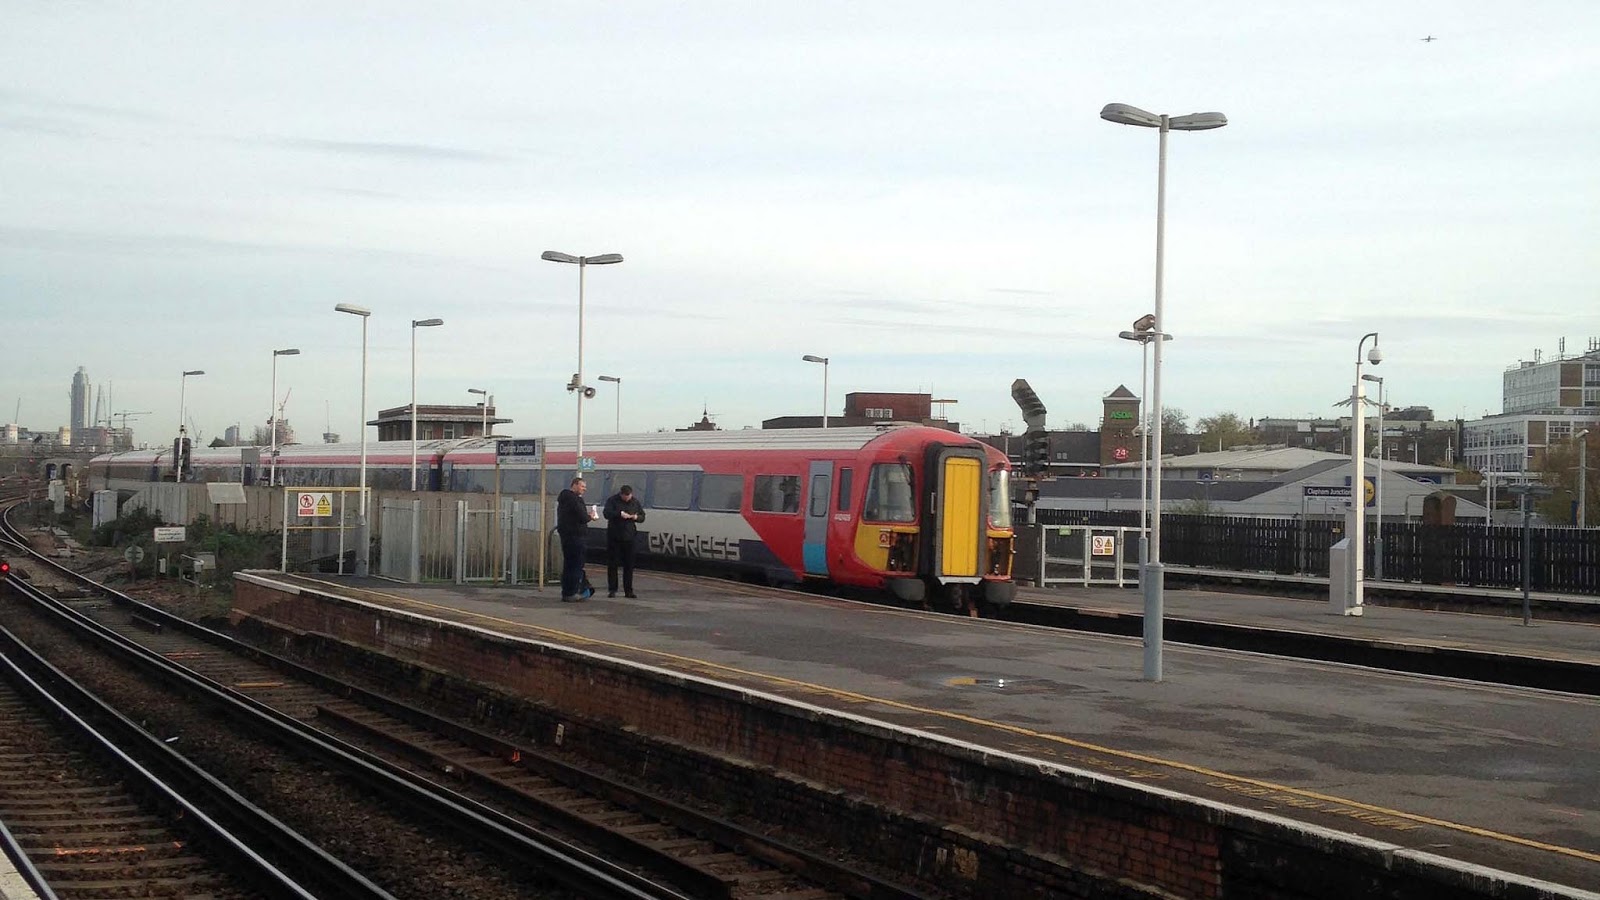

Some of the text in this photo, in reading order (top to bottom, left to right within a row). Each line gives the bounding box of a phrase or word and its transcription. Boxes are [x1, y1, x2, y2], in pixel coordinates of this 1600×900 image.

[1110, 411, 1133, 419] ASDA
[499, 444, 516, 454] Clapham
[516, 444, 534, 453] Junction
[1115, 448, 1126, 456] 24
